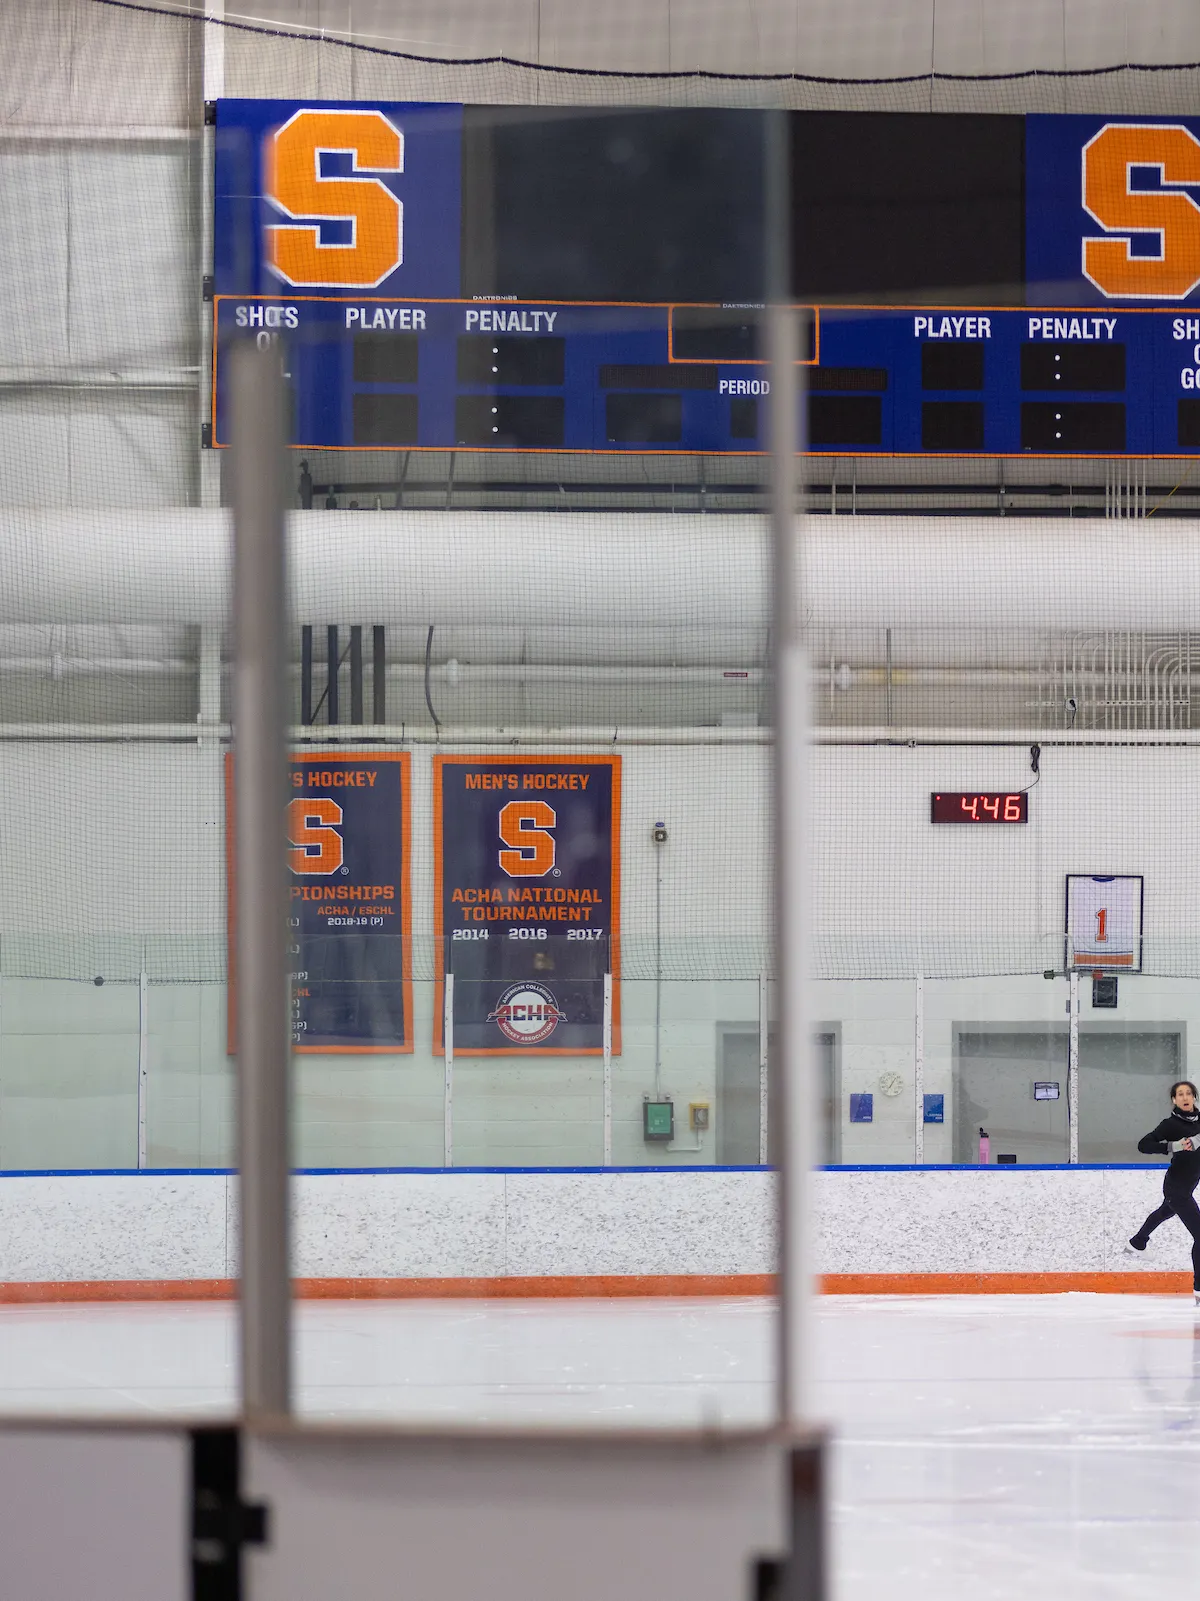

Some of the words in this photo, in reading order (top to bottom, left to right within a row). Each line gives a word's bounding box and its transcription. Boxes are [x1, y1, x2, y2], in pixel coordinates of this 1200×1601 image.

[262, 109, 404, 288] S
[235, 306, 299, 329] SHOTS
[345, 308, 427, 330] PLAYER
[465, 310, 558, 332] PENALTY
[914, 317, 991, 338] PLAYER
[1028, 318, 1117, 339] PENALTY
[256, 331, 279, 352] O
[719, 380, 770, 395] PERIOD
[308, 771, 378, 787] HOCKEY
[465, 774, 519, 790] MEN'S
[523, 774, 590, 790] HOCKEY
[285, 798, 343, 875] S
[499, 801, 556, 877] S
[289, 886, 395, 900] PIONSHIPS
[452, 888, 502, 903] ACHA
[507, 888, 602, 903] NATIONAL
[317, 906, 349, 916] ACHA
[359, 906, 395, 916] ESCHL
[461, 906, 593, 921] TOURNAMENT
[328, 917, 368, 926] 2018-19
[370, 917, 384, 926] (P)
[1095, 907, 1108, 943] 1
[452, 928, 489, 941] 2014
[509, 928, 548, 940] 2016
[567, 928, 603, 941] 2017
[495, 1005, 559, 1021] ACHA
[502, 1022, 520, 1039] HOCKEY
